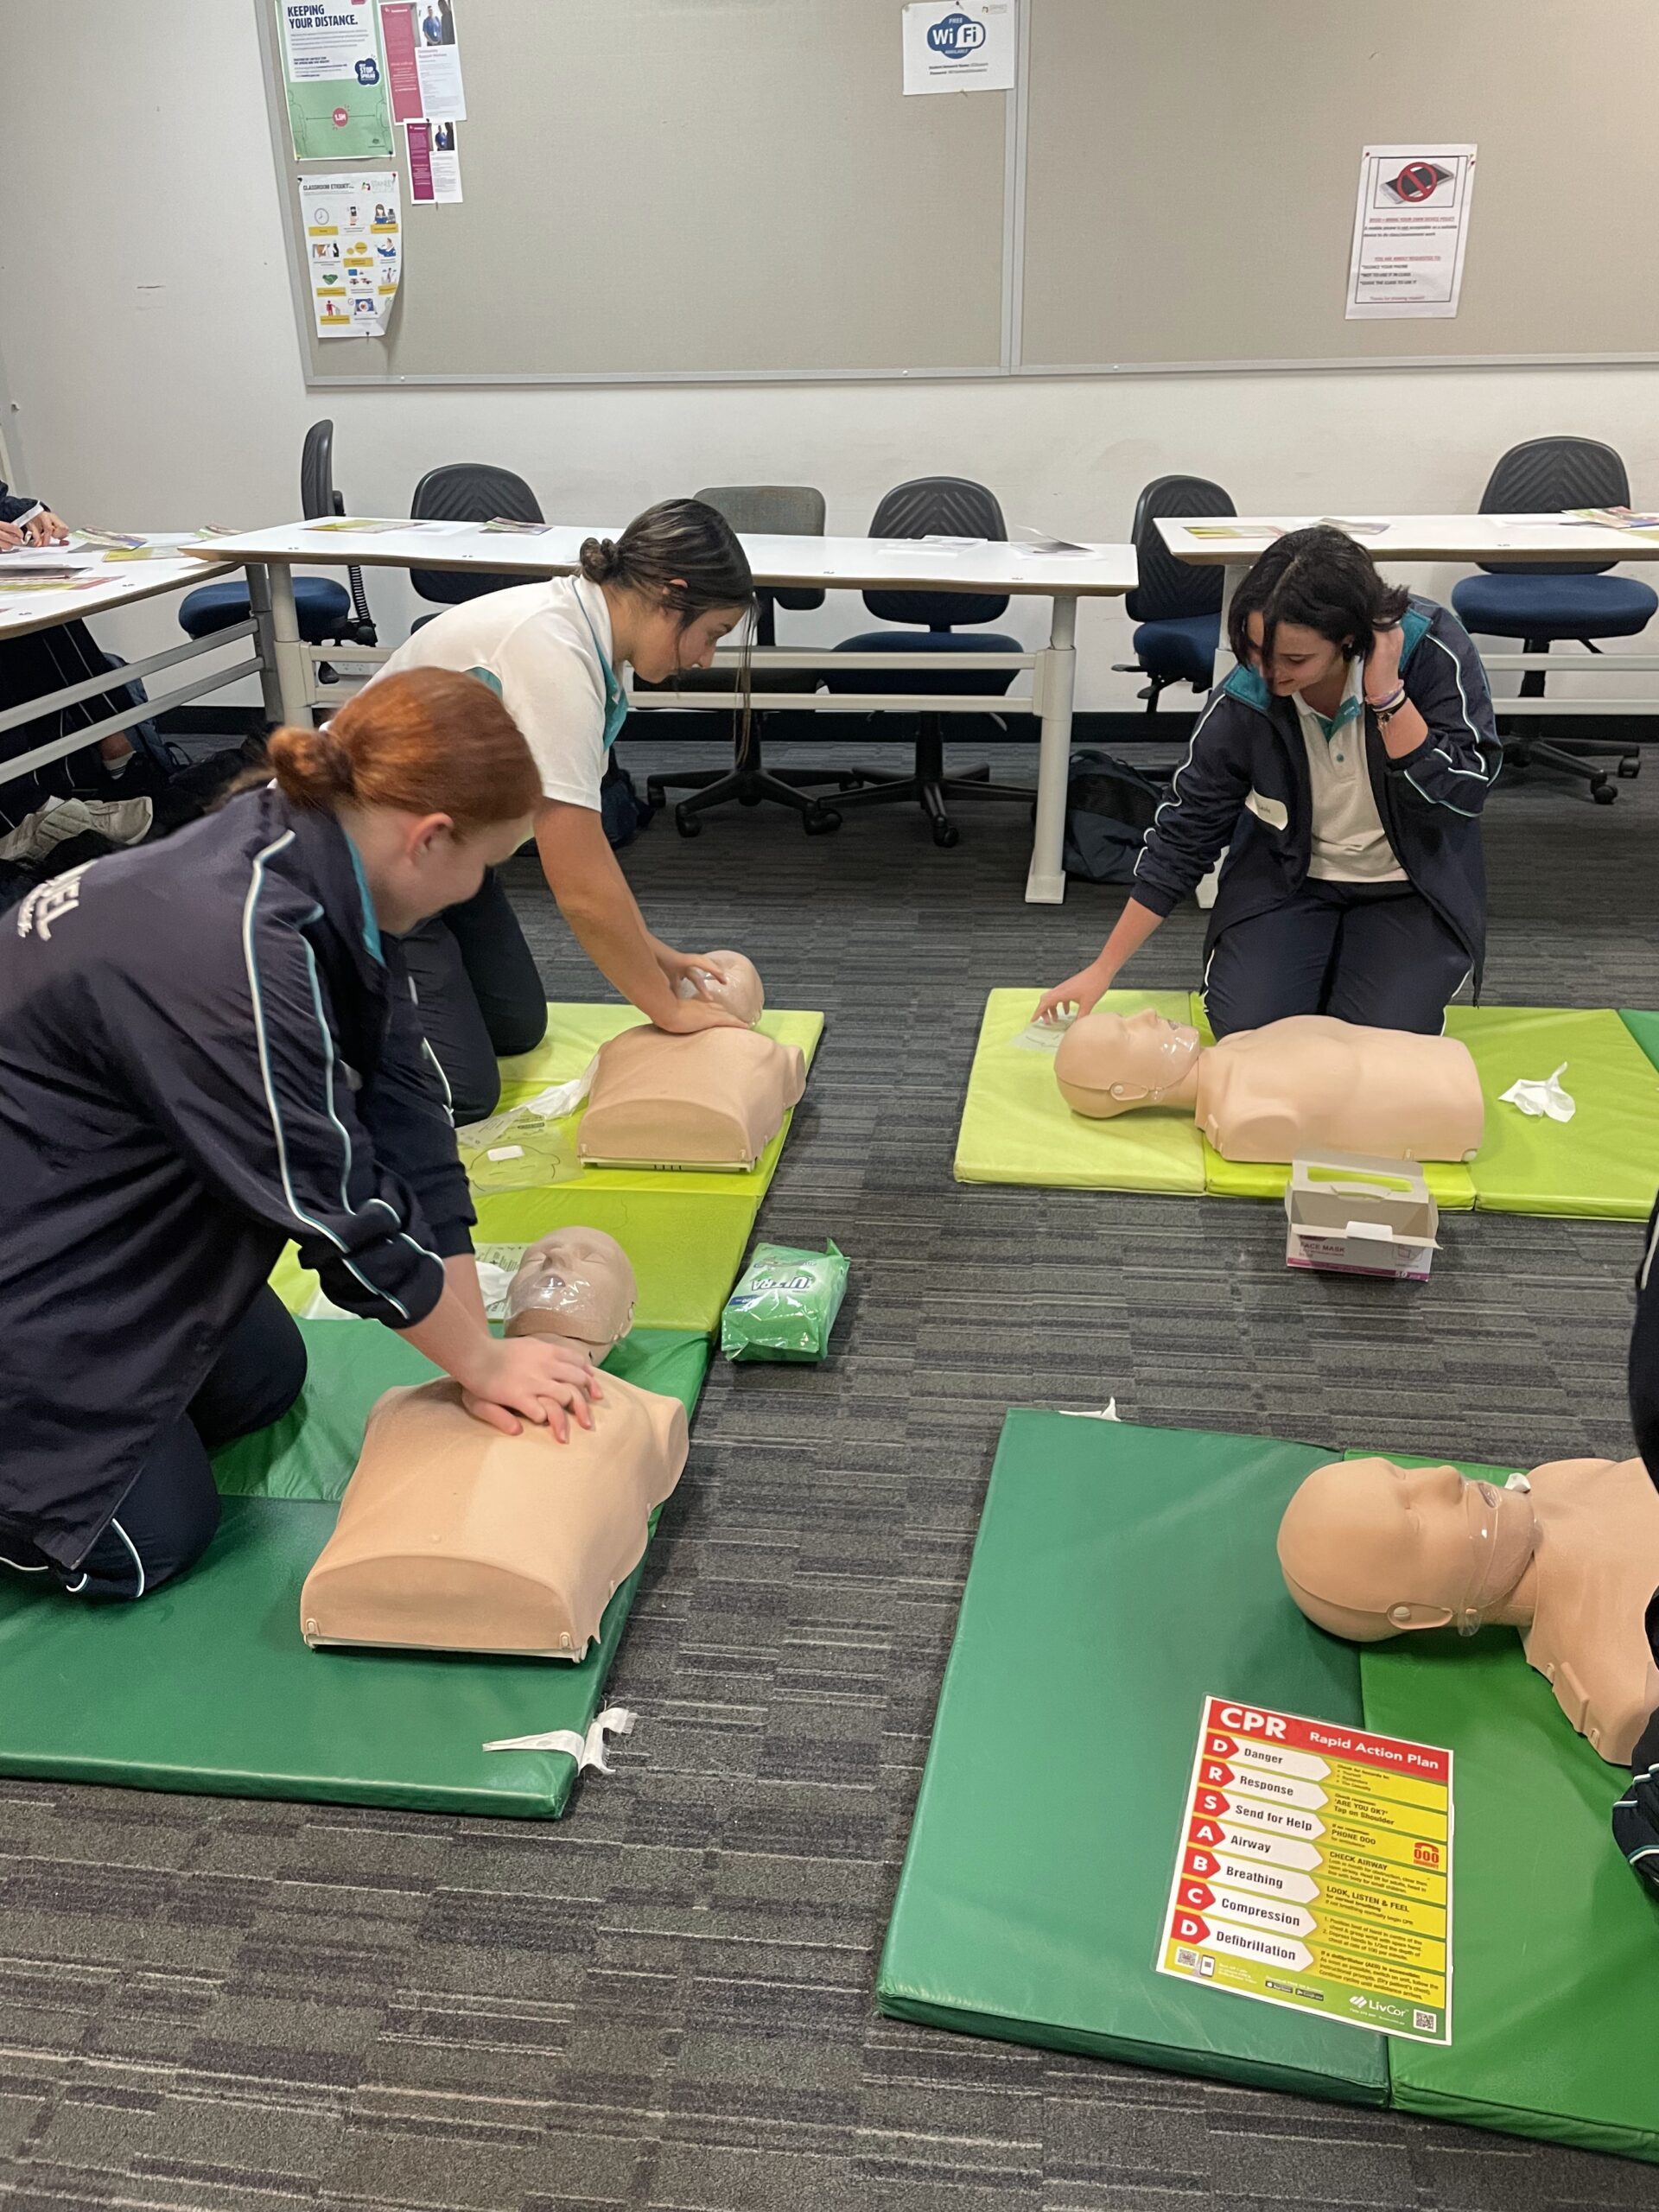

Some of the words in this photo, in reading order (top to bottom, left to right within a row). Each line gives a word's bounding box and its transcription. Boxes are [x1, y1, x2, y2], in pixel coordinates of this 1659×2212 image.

[288, 4, 324, 17] KEEPING
[289, 18, 314, 29] YOUR
[315, 15, 359, 28] DISTANCE.
[932, 28, 954, 45] Wi
[963, 26, 977, 42] Fi
[1300, 1241, 1323, 1251] FACE
[1322, 1243, 1345, 1253] MASK
[1220, 1707, 1287, 1739] CPR
[1310, 1732, 1351, 1749] Rapid
[1355, 1743, 1403, 1761] Action
[1407, 1753, 1439, 1770] Plan
[1212, 1738, 1228, 1752] D
[1244, 1748, 1284, 1764] Danger
[1209, 1766, 1223, 1782] R
[1240, 1776, 1294, 1796] Response
[1204, 1795, 1217, 1810] S
[1236, 1805, 1264, 1820] Send
[1267, 1812, 1284, 1824] for
[1286, 1816, 1313, 1831] Help
[1361, 1812, 1394, 1825] Shoulder
[1196, 1825, 1214, 1841] A
[1230, 1835, 1271, 1853] Airway
[1332, 1829, 1357, 1840] PHONE
[1330, 1852, 1355, 1862] CHECK
[1358, 1858, 1388, 1870] AIRWAY
[1414, 1848, 1439, 1863] 000
[1193, 1855, 1208, 1872] B
[1226, 1866, 1283, 1889] Breathing
[1187, 1888, 1203, 1904] C
[1222, 1897, 1300, 1926] Compression
[1326, 1885, 1350, 1897] LOOK,
[1352, 1892, 1379, 1904] LISTEN
[1390, 1901, 1409, 1911] FEEL
[1180, 1919, 1198, 1936] D
[1217, 1931, 1296, 1961] Defibrillation
[1369, 1999, 1405, 2017] LivCor
